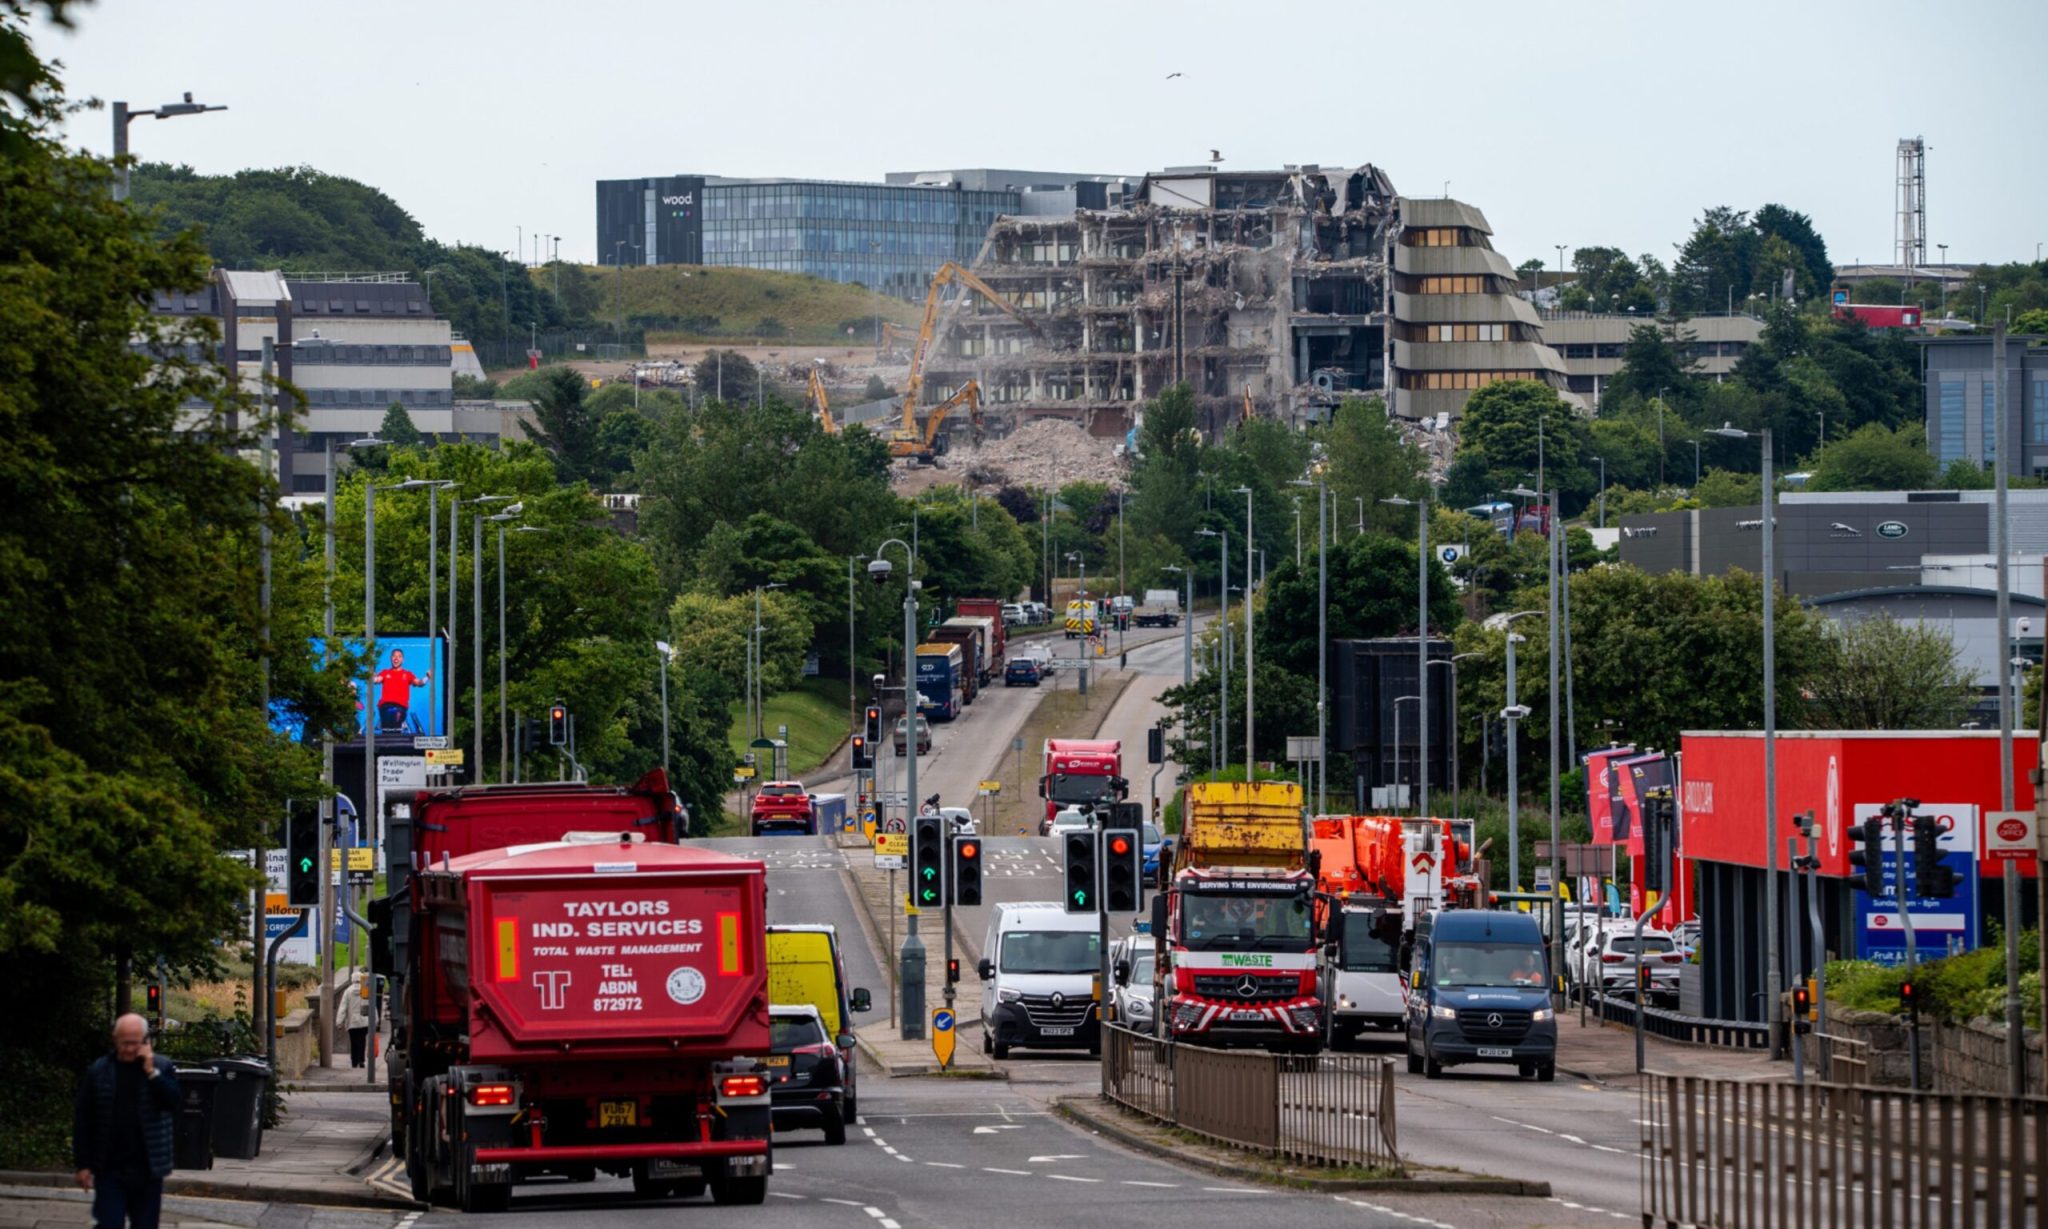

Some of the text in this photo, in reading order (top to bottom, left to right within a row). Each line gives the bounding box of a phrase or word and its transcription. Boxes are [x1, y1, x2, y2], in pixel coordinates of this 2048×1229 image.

[382, 760, 421, 769] Wellington
[1247, 882, 1297, 890] ENVIRONMENT
[265, 904, 300, 916] alford
[563, 900, 670, 918] TAYLORS
[532, 919, 703, 938] IND. SERVICES
[533, 943, 703, 956] TOTAL WASTE MANAGEMENT
[1233, 954, 1272, 967] WASTE
[601, 965, 633, 978] TEL:
[598, 981, 638, 994] ABDN
[593, 998, 643, 1011] 872972
